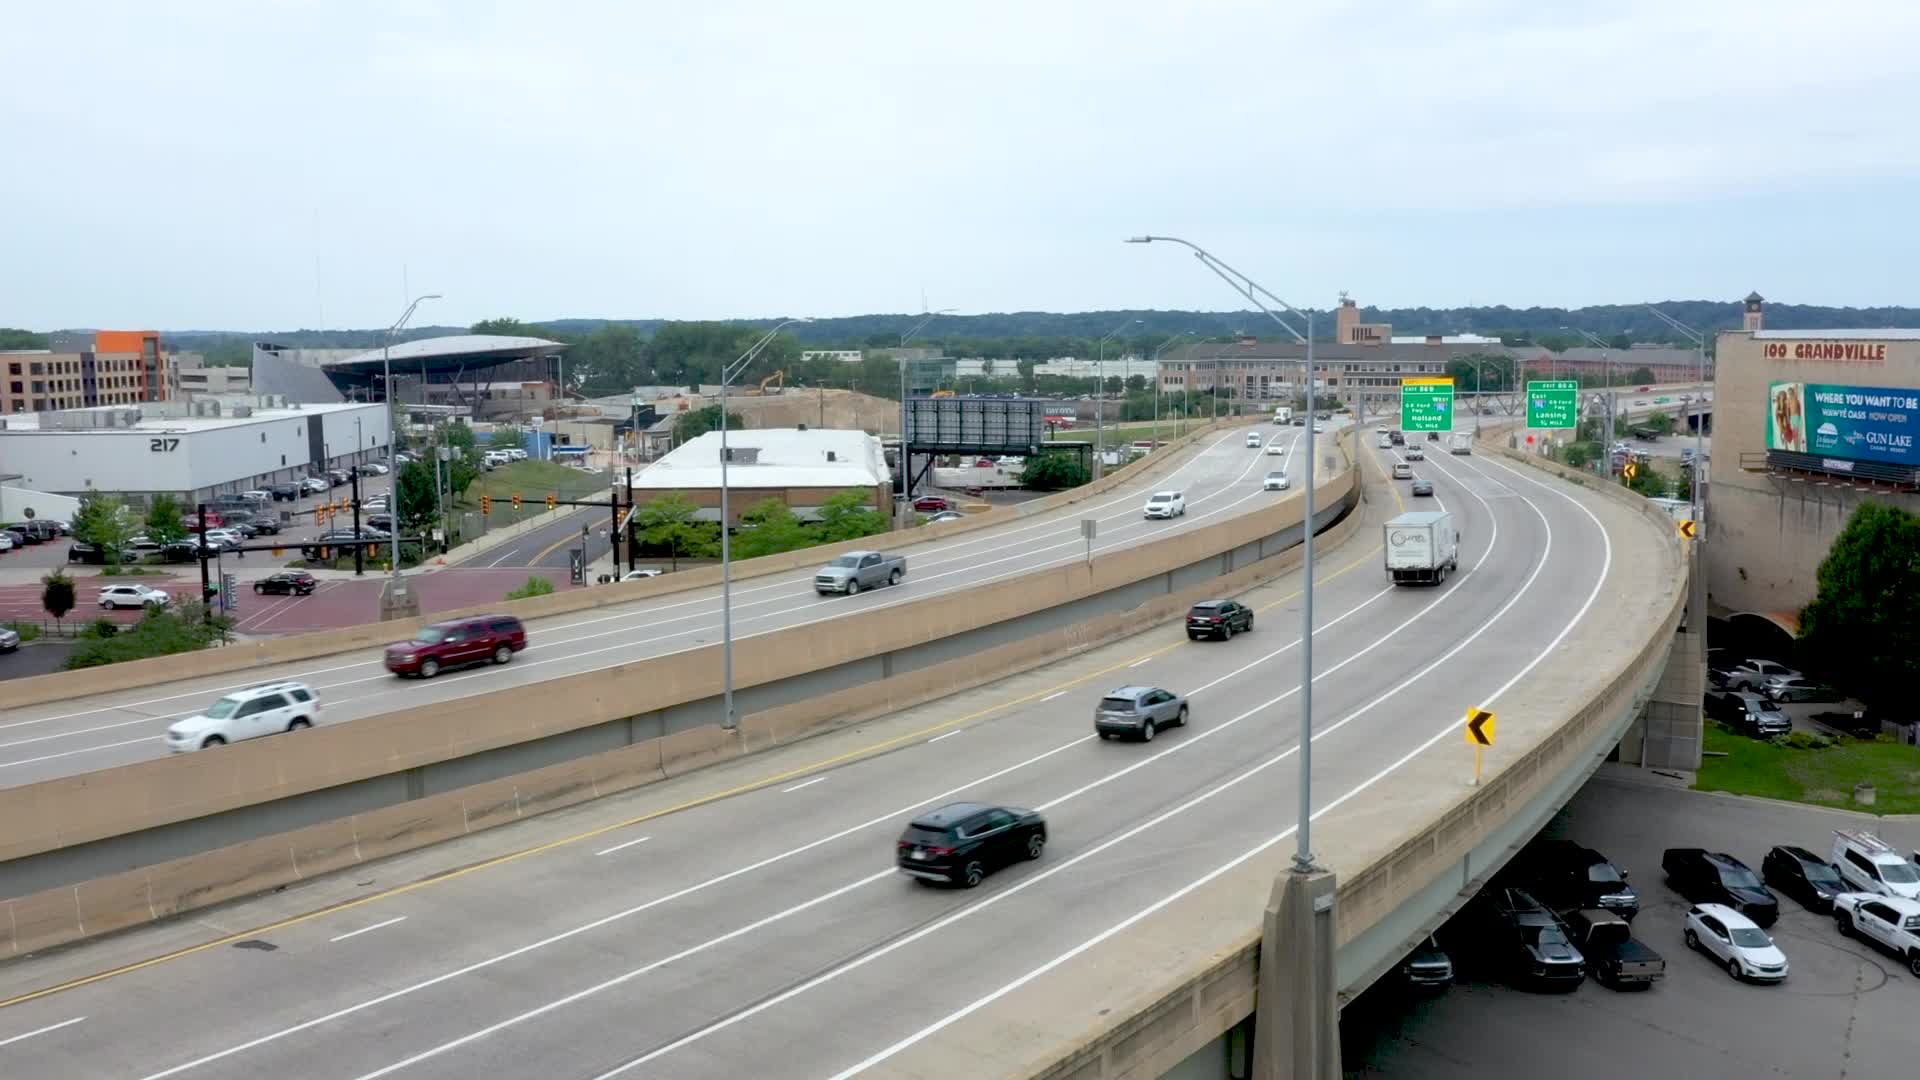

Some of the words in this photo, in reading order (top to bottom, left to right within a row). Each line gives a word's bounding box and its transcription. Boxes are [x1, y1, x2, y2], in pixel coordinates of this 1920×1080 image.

[1764, 343, 1787, 357] 100
[1794, 343, 1886, 360] GRANDVILLE
[1815, 392, 1844, 404] WHERE
[1845, 393, 1863, 405] YOU
[1865, 395, 1891, 407] WANT
[1892, 397, 1905, 409] TO
[1906, 397, 1918, 409] BE
[1535, 412, 1567, 420] Lansing
[151, 438, 180, 452] 217
[1866, 431, 1887, 444] GUN
[1888, 433, 1912, 447] LAKE
